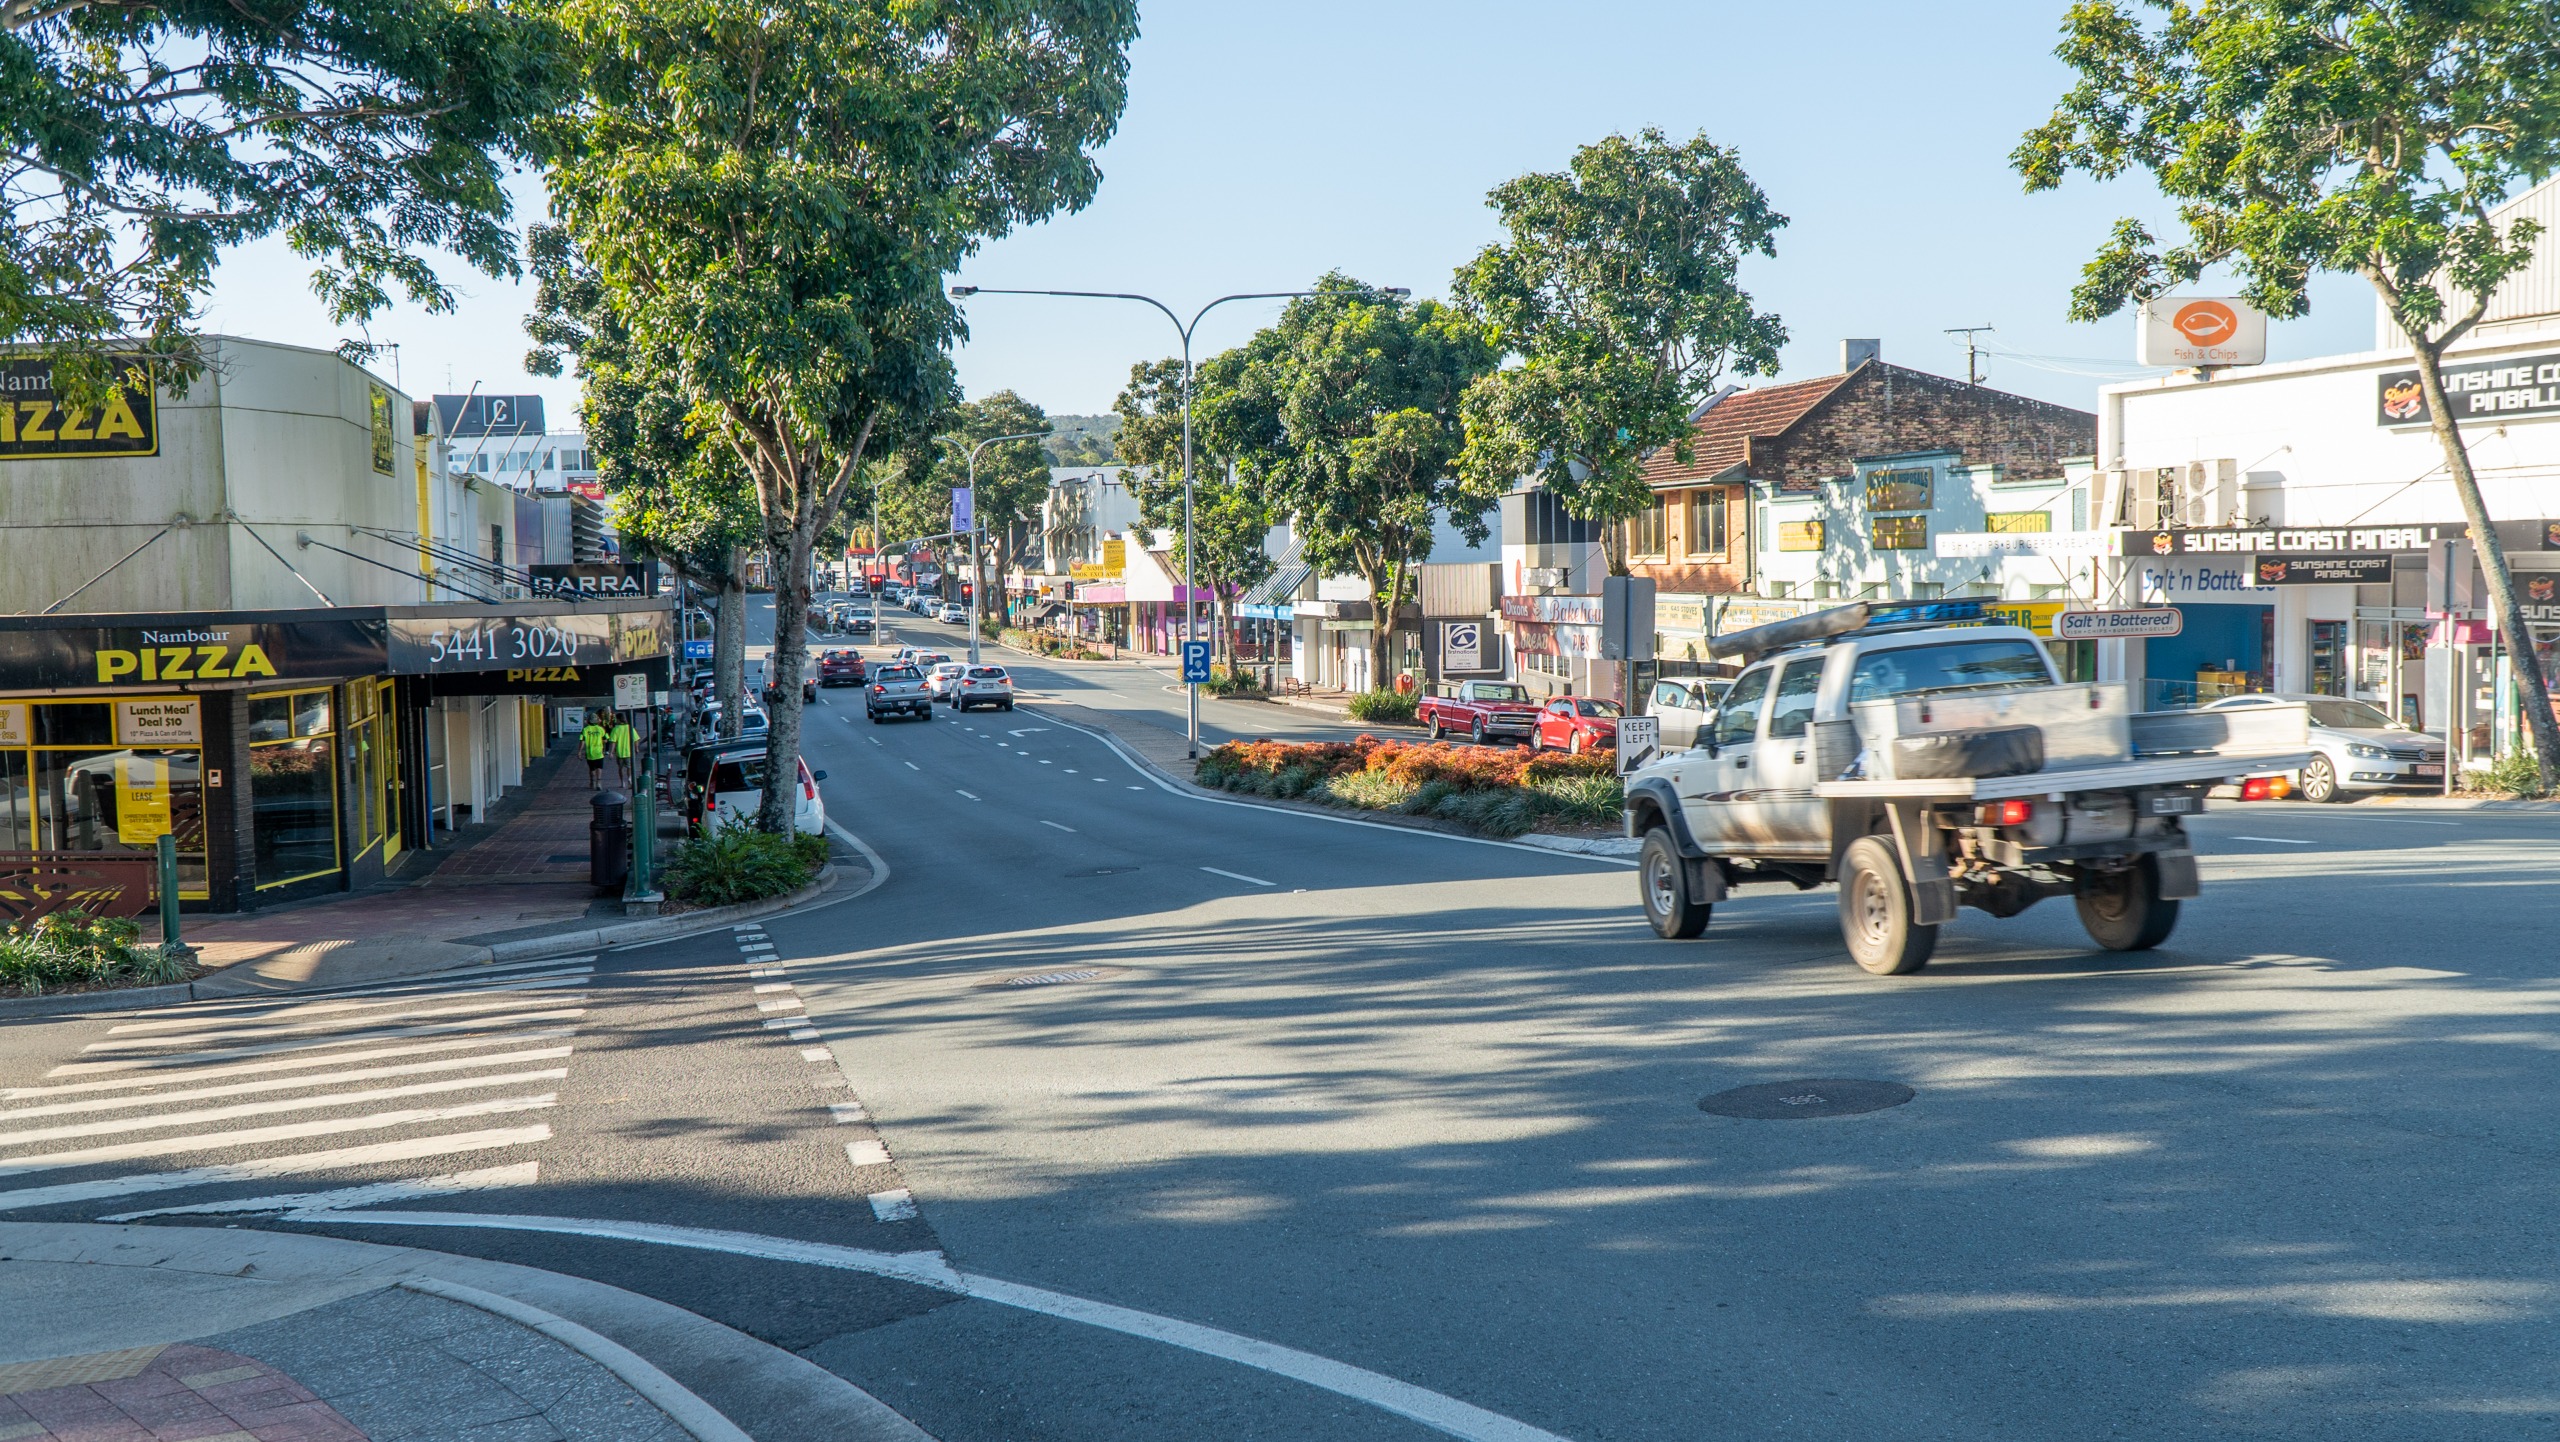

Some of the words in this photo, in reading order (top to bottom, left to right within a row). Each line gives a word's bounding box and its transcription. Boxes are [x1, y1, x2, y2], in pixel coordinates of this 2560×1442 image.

[2174, 348, 2194, 359] Fish
[2198, 348, 2205, 359] &
[2208, 348, 2238, 361] Chips
[2440, 365, 2534, 393] UNSHINE
[2470, 386, 2560, 412] PINBALL
[2005, 539, 2053, 549] BURGERS
[2183, 533, 2275, 551] SUNSHINE
[2278, 531, 2347, 550] COAST
[2290, 559, 2346, 570] SUNSHINE
[2350, 559, 2388, 569] COAST
[2314, 568, 2363, 578] PINBALL
[534, 576, 640, 592] GARRA
[1505, 599, 1529, 617] Dixons
[2066, 614, 2092, 628] Salt
[2109, 611, 2173, 627] Battered
[141, 629, 230, 644] Nambour
[430, 628, 499, 663] 5441
[511, 625, 578, 659] 3020
[624, 627, 660, 658] PIZZA
[1520, 631, 1549, 650] BREAD
[1572, 633, 1590, 652] PIES
[95, 644, 278, 683] PIZZA
[507, 666, 581, 682] PIZZA
[631, 676, 645, 686] 2P
[129, 705, 161, 716] Lunch
[164, 704, 190, 715] Meal
[138, 716, 163, 727] Deal
[165, 717, 183, 727] $10
[1624, 722, 1652, 732] KEEP
[1625, 733, 1651, 744] LEFT
[131, 792, 153, 802] LEASE
